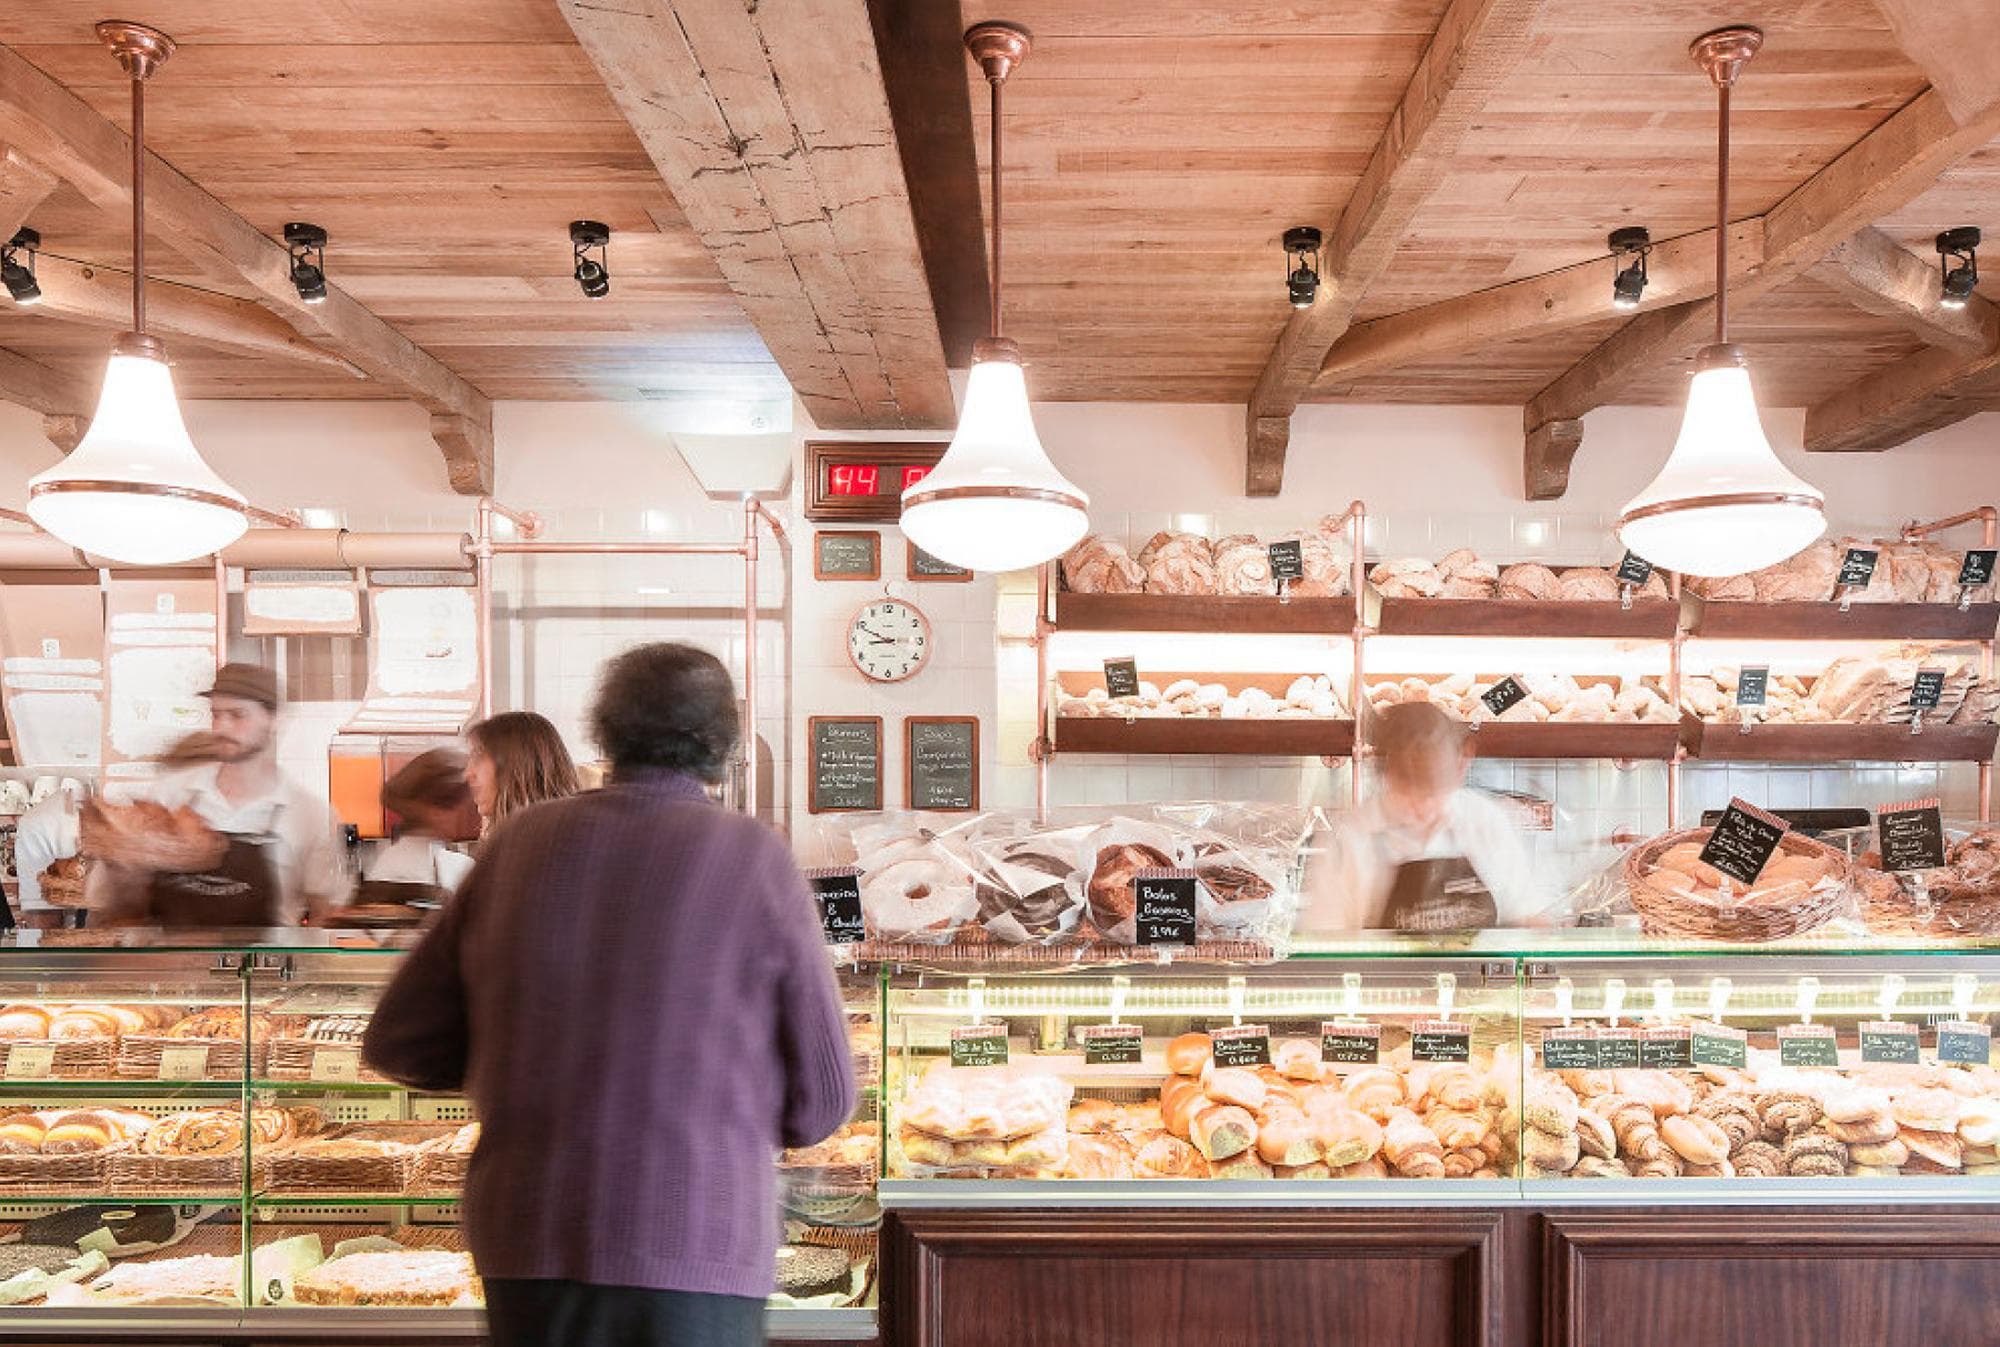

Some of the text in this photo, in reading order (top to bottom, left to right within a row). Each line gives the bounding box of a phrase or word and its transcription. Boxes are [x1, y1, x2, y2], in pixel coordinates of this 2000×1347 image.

[883, 605, 893, 613] 12
[912, 619, 919, 628] 2
[917, 637, 923, 646] 3
[885, 669, 891, 678] 6
